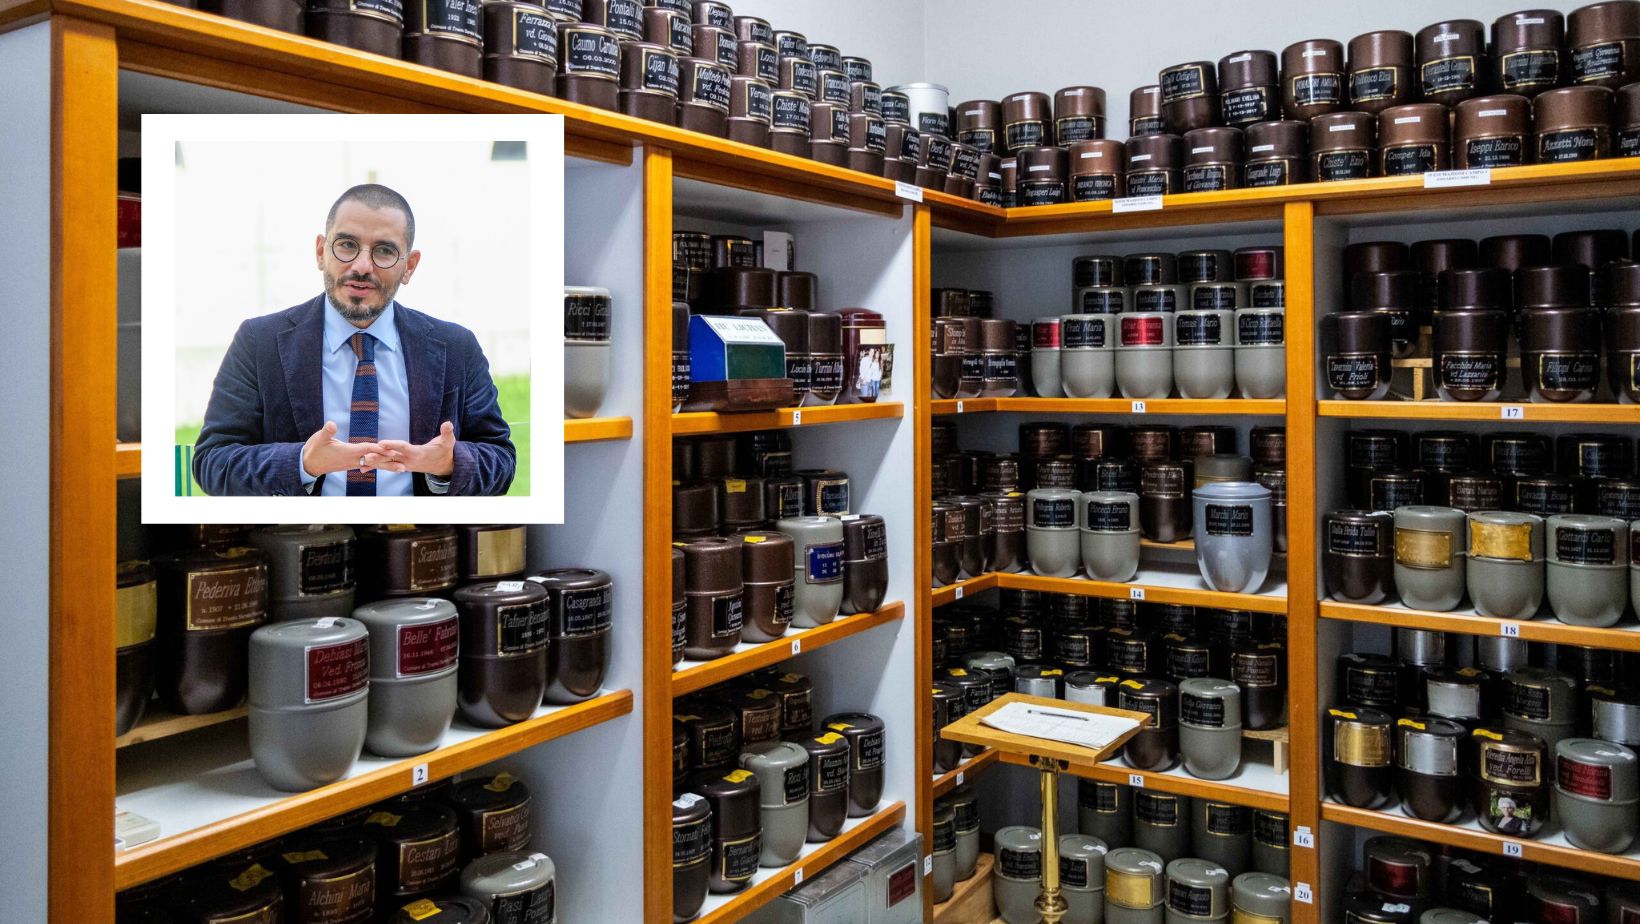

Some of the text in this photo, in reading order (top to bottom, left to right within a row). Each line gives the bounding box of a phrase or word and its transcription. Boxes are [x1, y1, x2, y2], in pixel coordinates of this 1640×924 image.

[1470, 141, 1494, 155] Iseppi
[568, 303, 591, 316] Ricci
[1134, 402, 1144, 411] 13
[1507, 408, 1518, 417] 17
[1231, 509, 1248, 519] Mario
[195, 579, 240, 599] Pederiva
[1132, 590, 1142, 598] 14
[1504, 626, 1517, 635] 18
[403, 628, 432, 646] Belle'
[794, 643, 799, 652] 6
[416, 767, 424, 781] 2
[1132, 776, 1142, 784] 15
[1299, 835, 1310, 845] 16
[1506, 845, 1519, 854] 19
[308, 888, 344, 907] Alchini
[1298, 891, 1310, 900] 20
